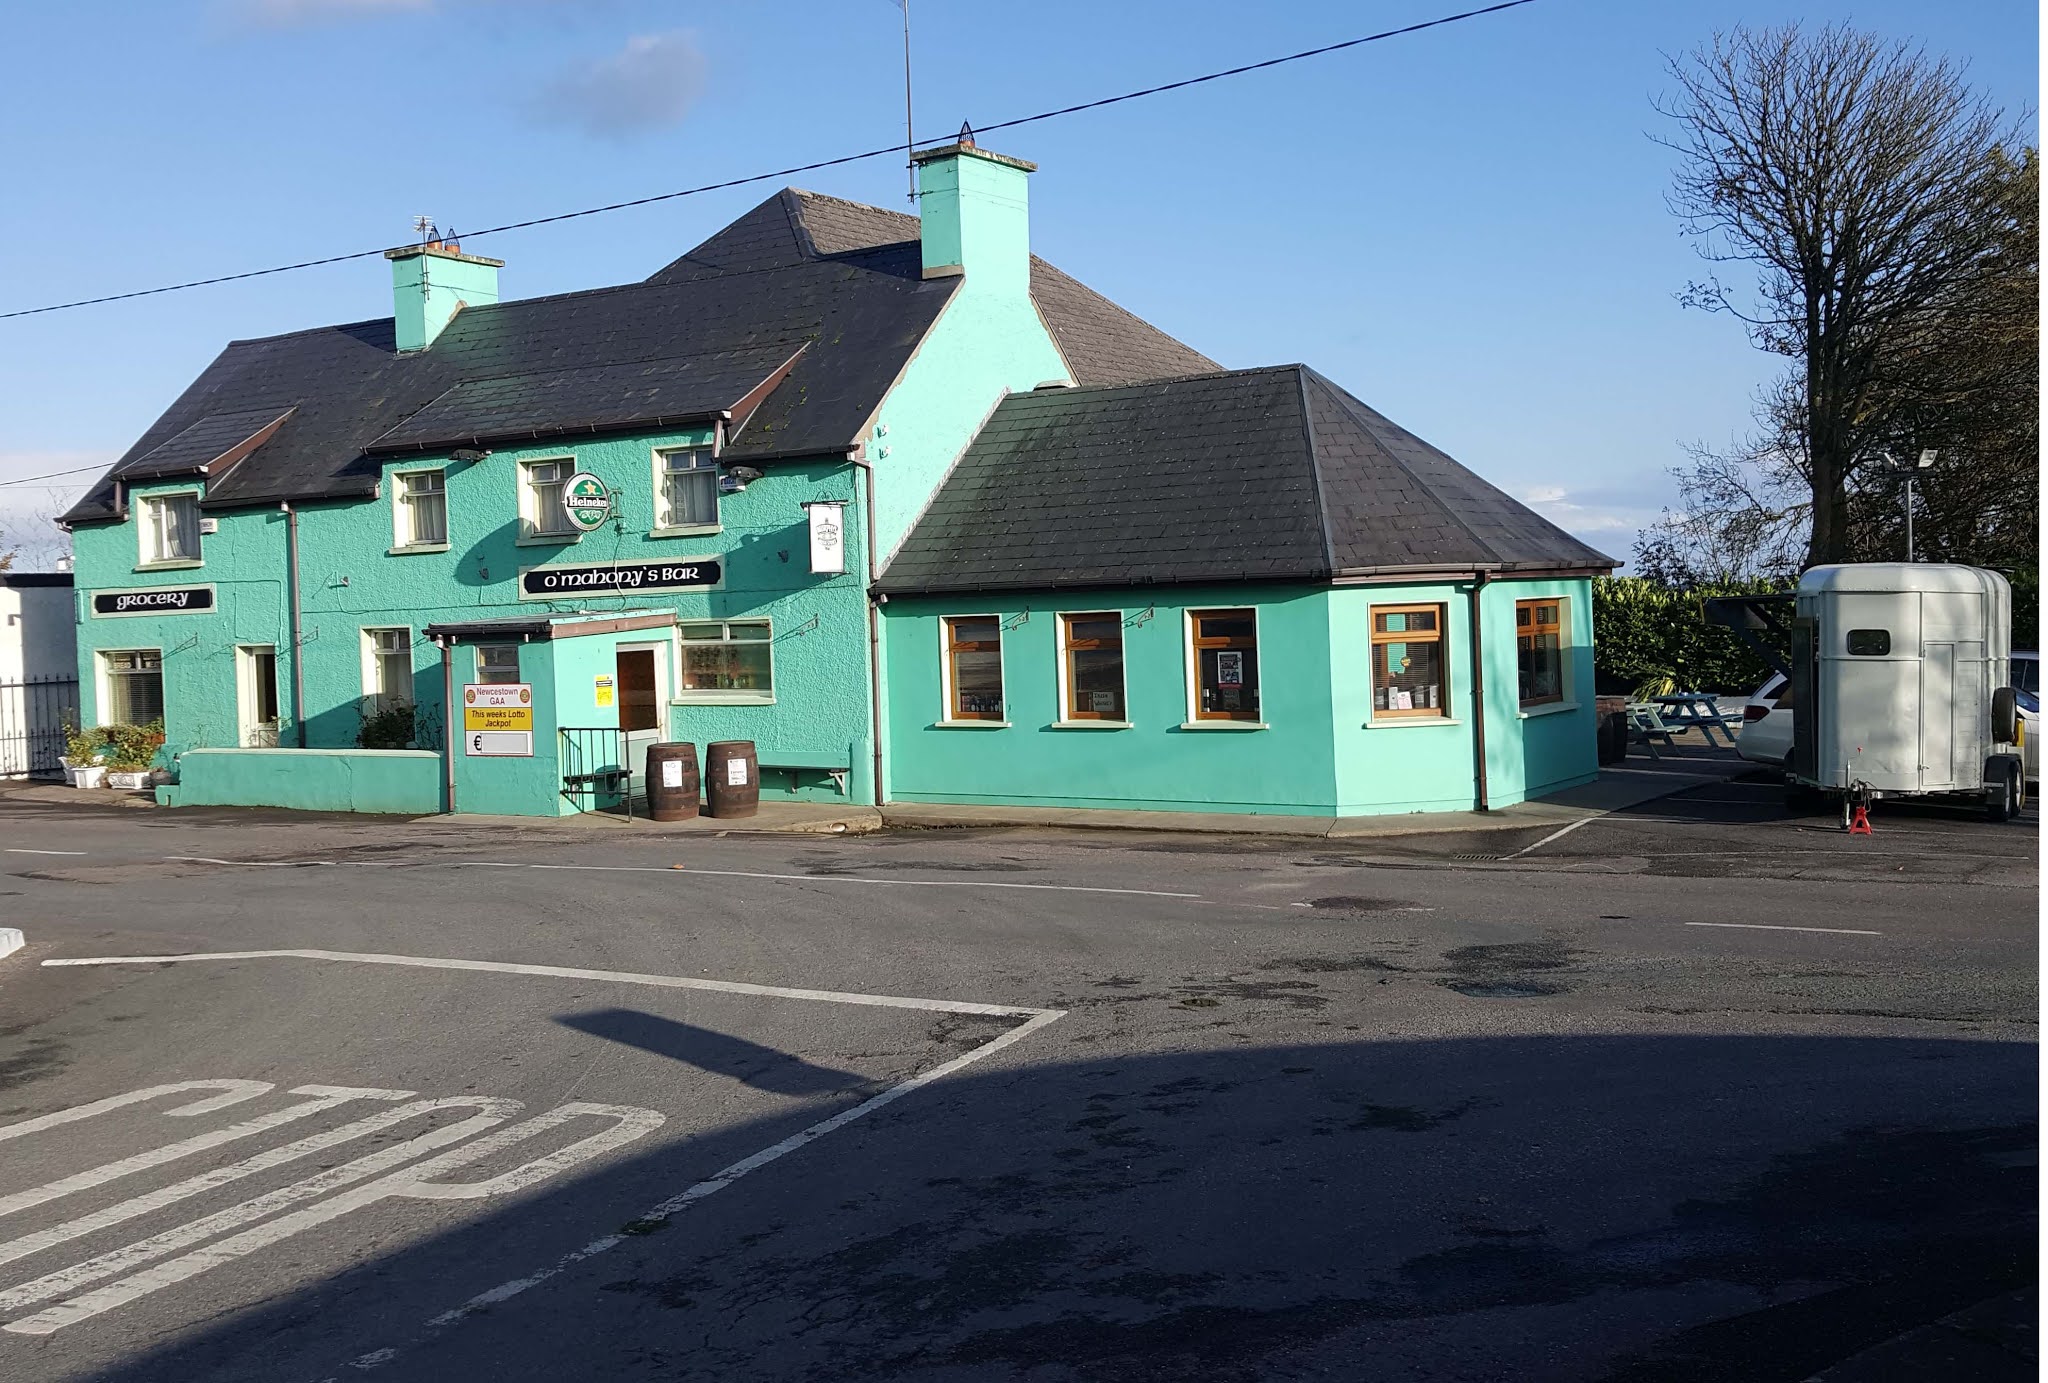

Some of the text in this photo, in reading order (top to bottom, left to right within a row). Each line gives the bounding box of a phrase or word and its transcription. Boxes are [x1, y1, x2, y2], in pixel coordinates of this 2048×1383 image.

[662, 567, 700, 581] BAR
[476, 687, 518, 696] Newcestown
[489, 697, 505, 705] GAA
[472, 710, 525, 718] This weeks Lotto
[485, 719, 511, 729] Jackpot
